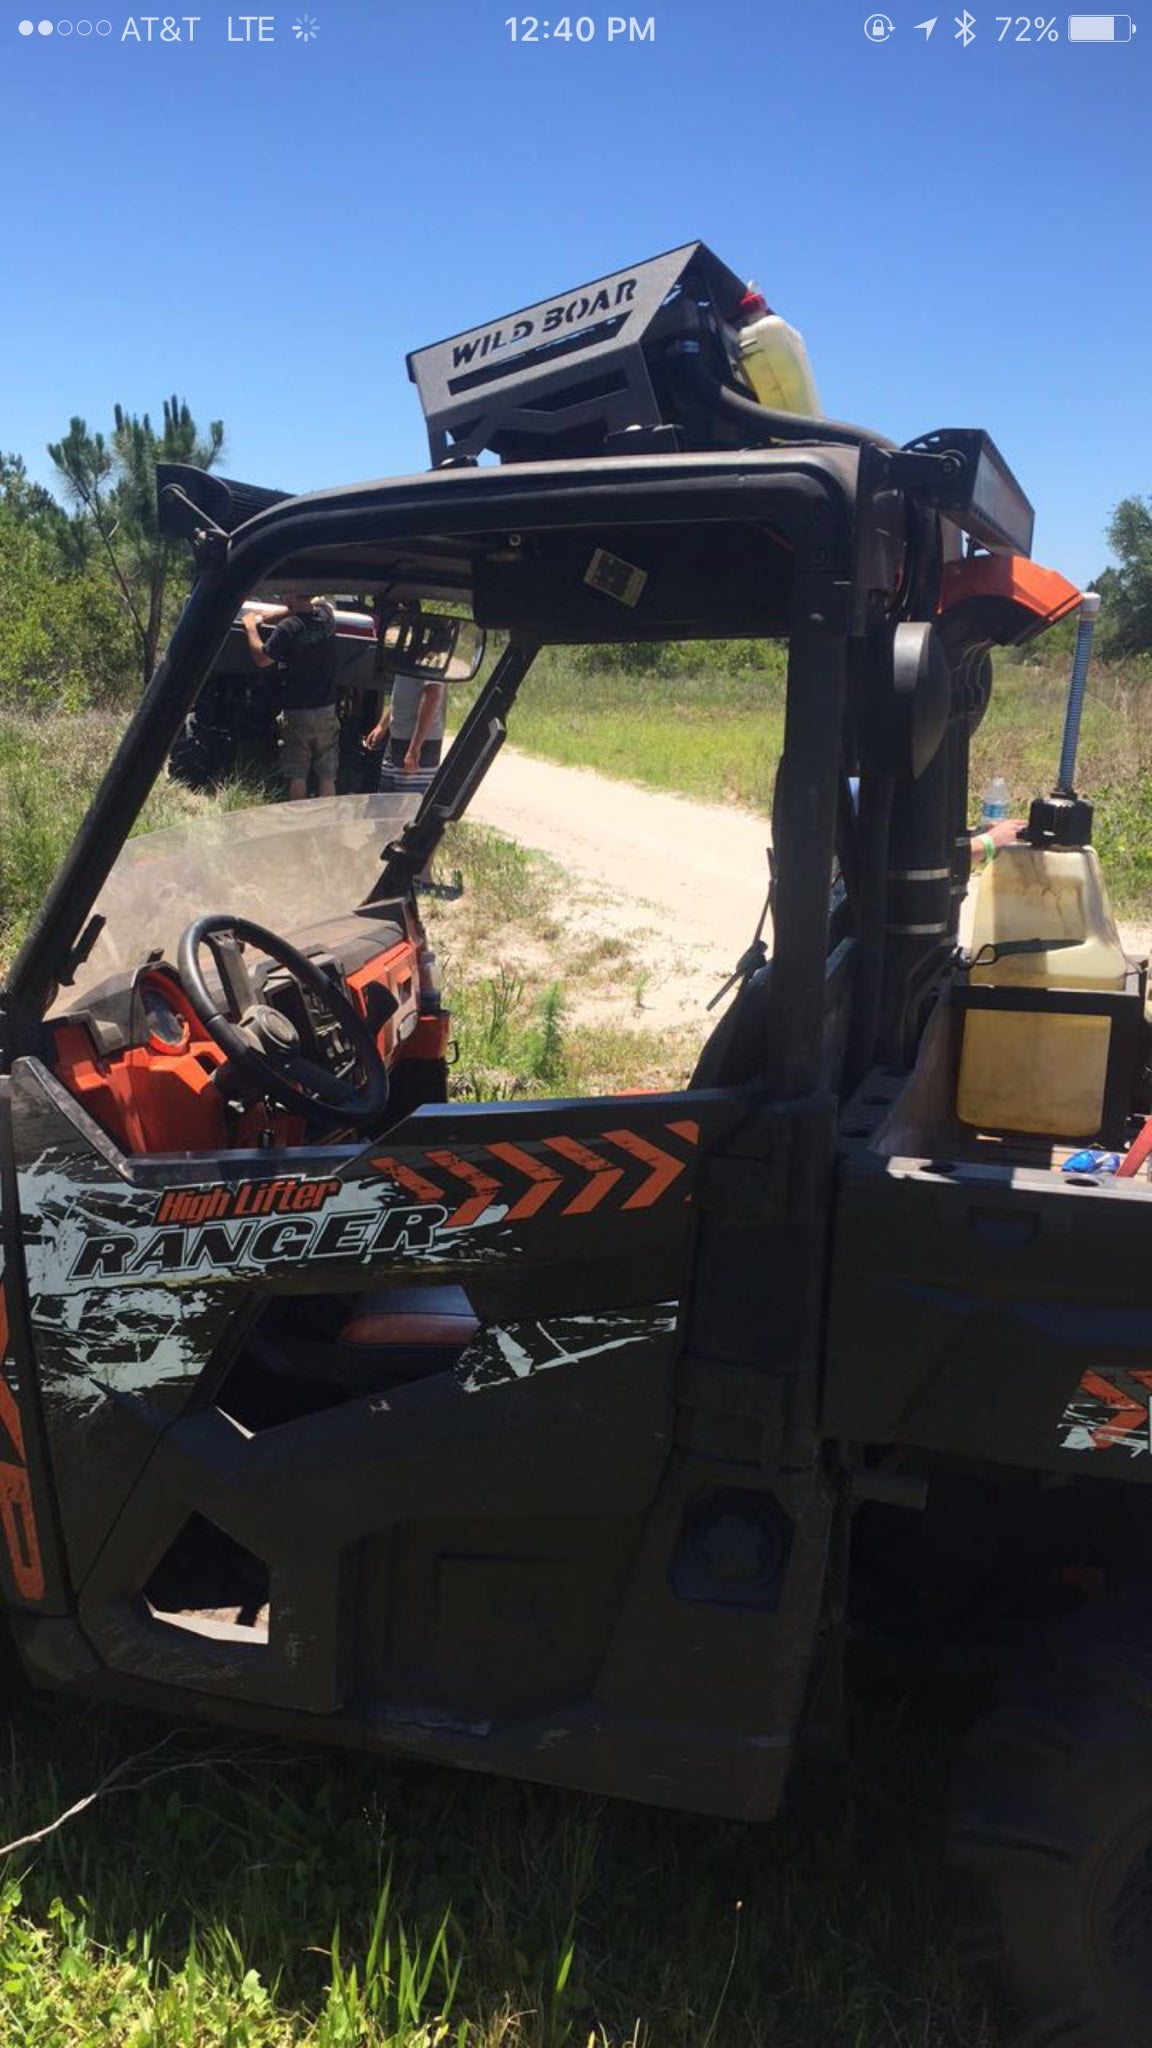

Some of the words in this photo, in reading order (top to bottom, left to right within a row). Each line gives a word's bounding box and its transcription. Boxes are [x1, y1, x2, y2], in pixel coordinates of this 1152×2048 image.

[452, 320, 535, 369] WILD
[541, 277, 638, 333] BOAR
[155, 1189, 232, 1227] High
[232, 1177, 342, 1219] Lifter
[67, 1203, 448, 1281] RANGER
